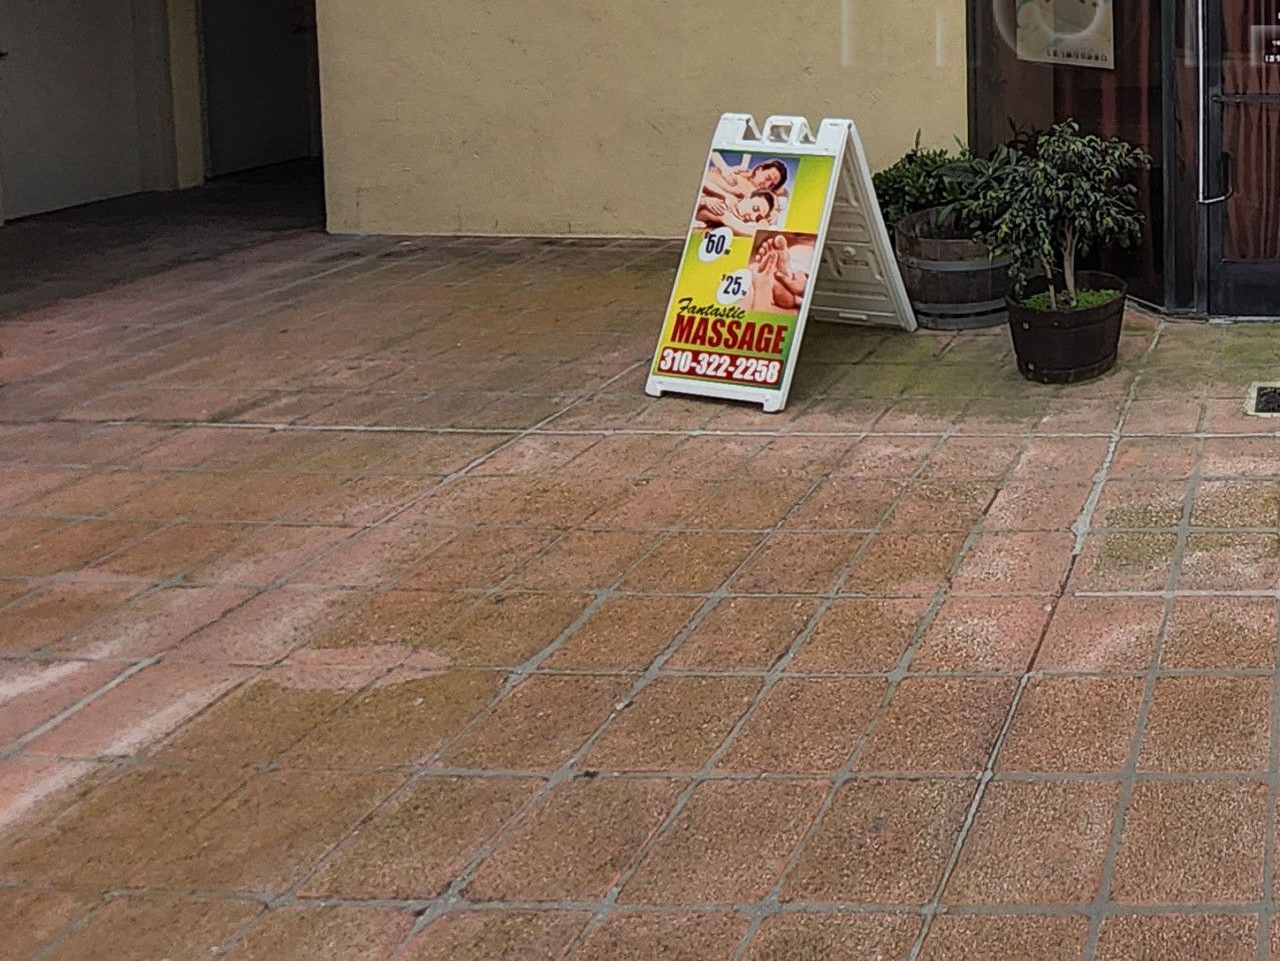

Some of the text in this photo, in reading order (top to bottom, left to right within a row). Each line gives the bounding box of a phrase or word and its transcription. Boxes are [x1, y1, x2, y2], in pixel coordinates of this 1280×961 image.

[677, 296, 747, 320] Fantastic
[670, 314, 789, 355] MASSAGE
[659, 348, 782, 384] 310-322-2258
